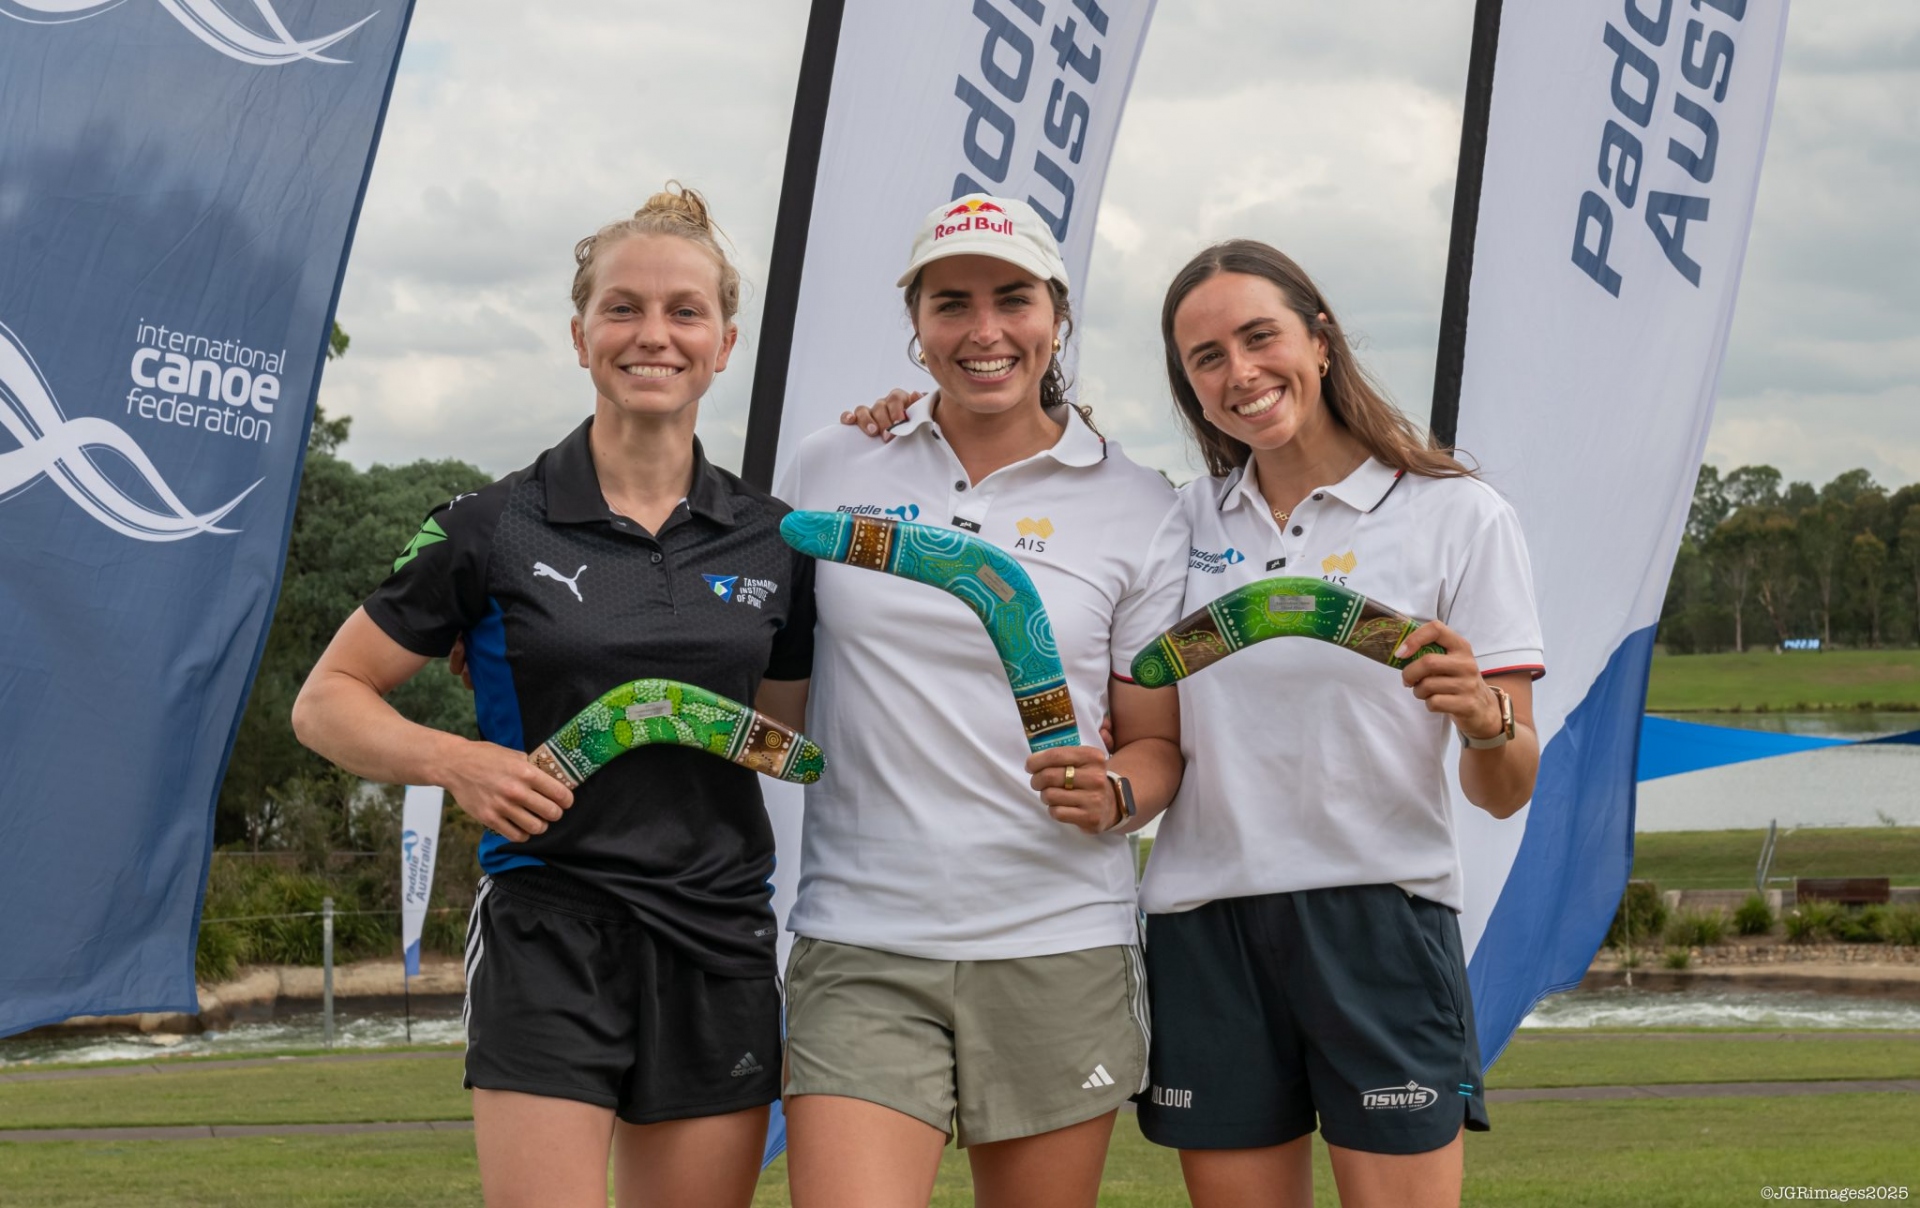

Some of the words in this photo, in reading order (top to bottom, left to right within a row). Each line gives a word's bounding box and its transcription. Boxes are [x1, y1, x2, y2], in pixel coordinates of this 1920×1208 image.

[934, 217, 971, 241] Red
[975, 217, 1013, 236] Bull
[136, 317, 286, 375] international
[131, 347, 280, 413] canoe
[126, 387, 272, 444] federation
[836, 505, 882, 515] Paddle
[1014, 537, 1047, 552] AIS
[1190, 547, 1222, 564] addle
[736, 594, 746, 602] OF
[406, 856, 419, 904] Paddle
[416, 836, 432, 902] Australia
